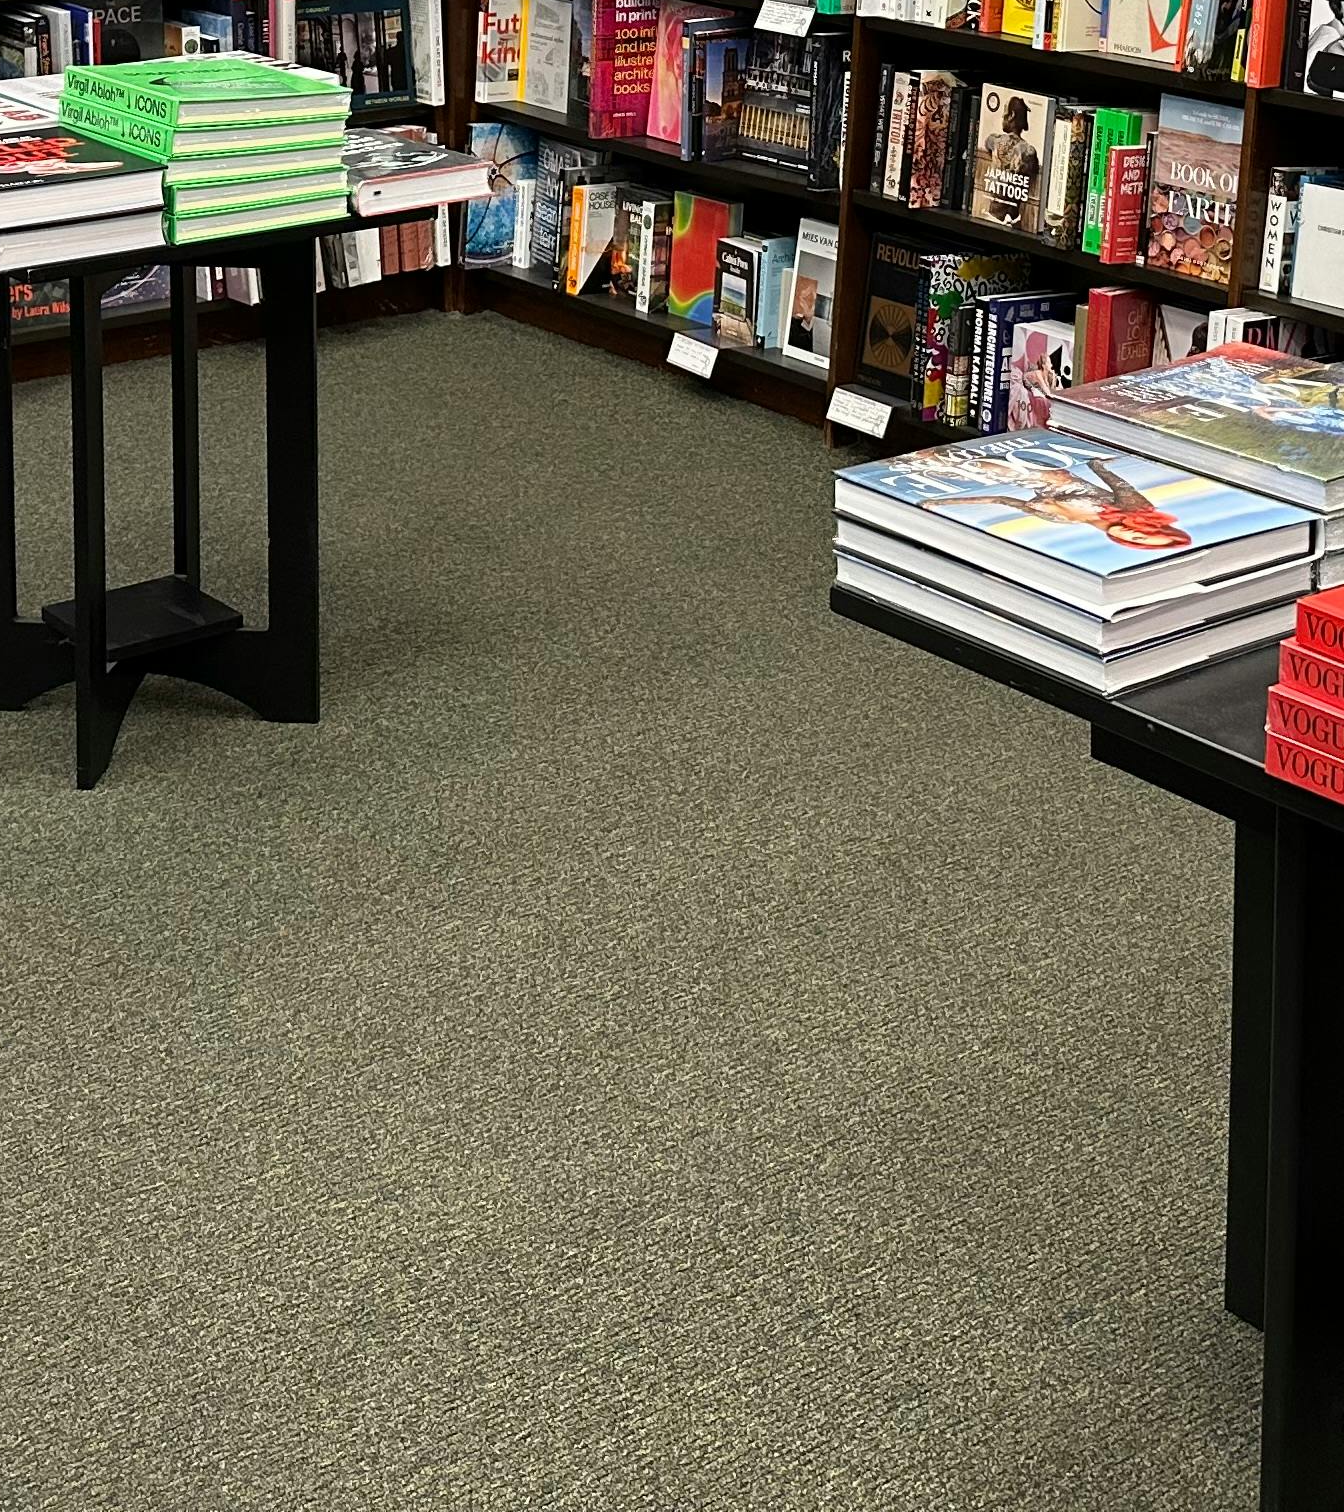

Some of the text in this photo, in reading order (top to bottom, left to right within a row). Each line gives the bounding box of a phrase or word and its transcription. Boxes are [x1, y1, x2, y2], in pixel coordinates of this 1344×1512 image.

[615, 9, 657, 24] in print
[614, 28, 640, 40] 100
[68, 76, 90, 97] Virgil
[135, 92, 167, 118] ICONS
[613, 82, 651, 95] books
[985, 168, 1029, 189] JAPANESE
[984, 180, 1029, 202] TATTOOS
[1263, 200, 1283, 271] WOMEN
[968, 309, 984, 408] NORMA KAMALI
